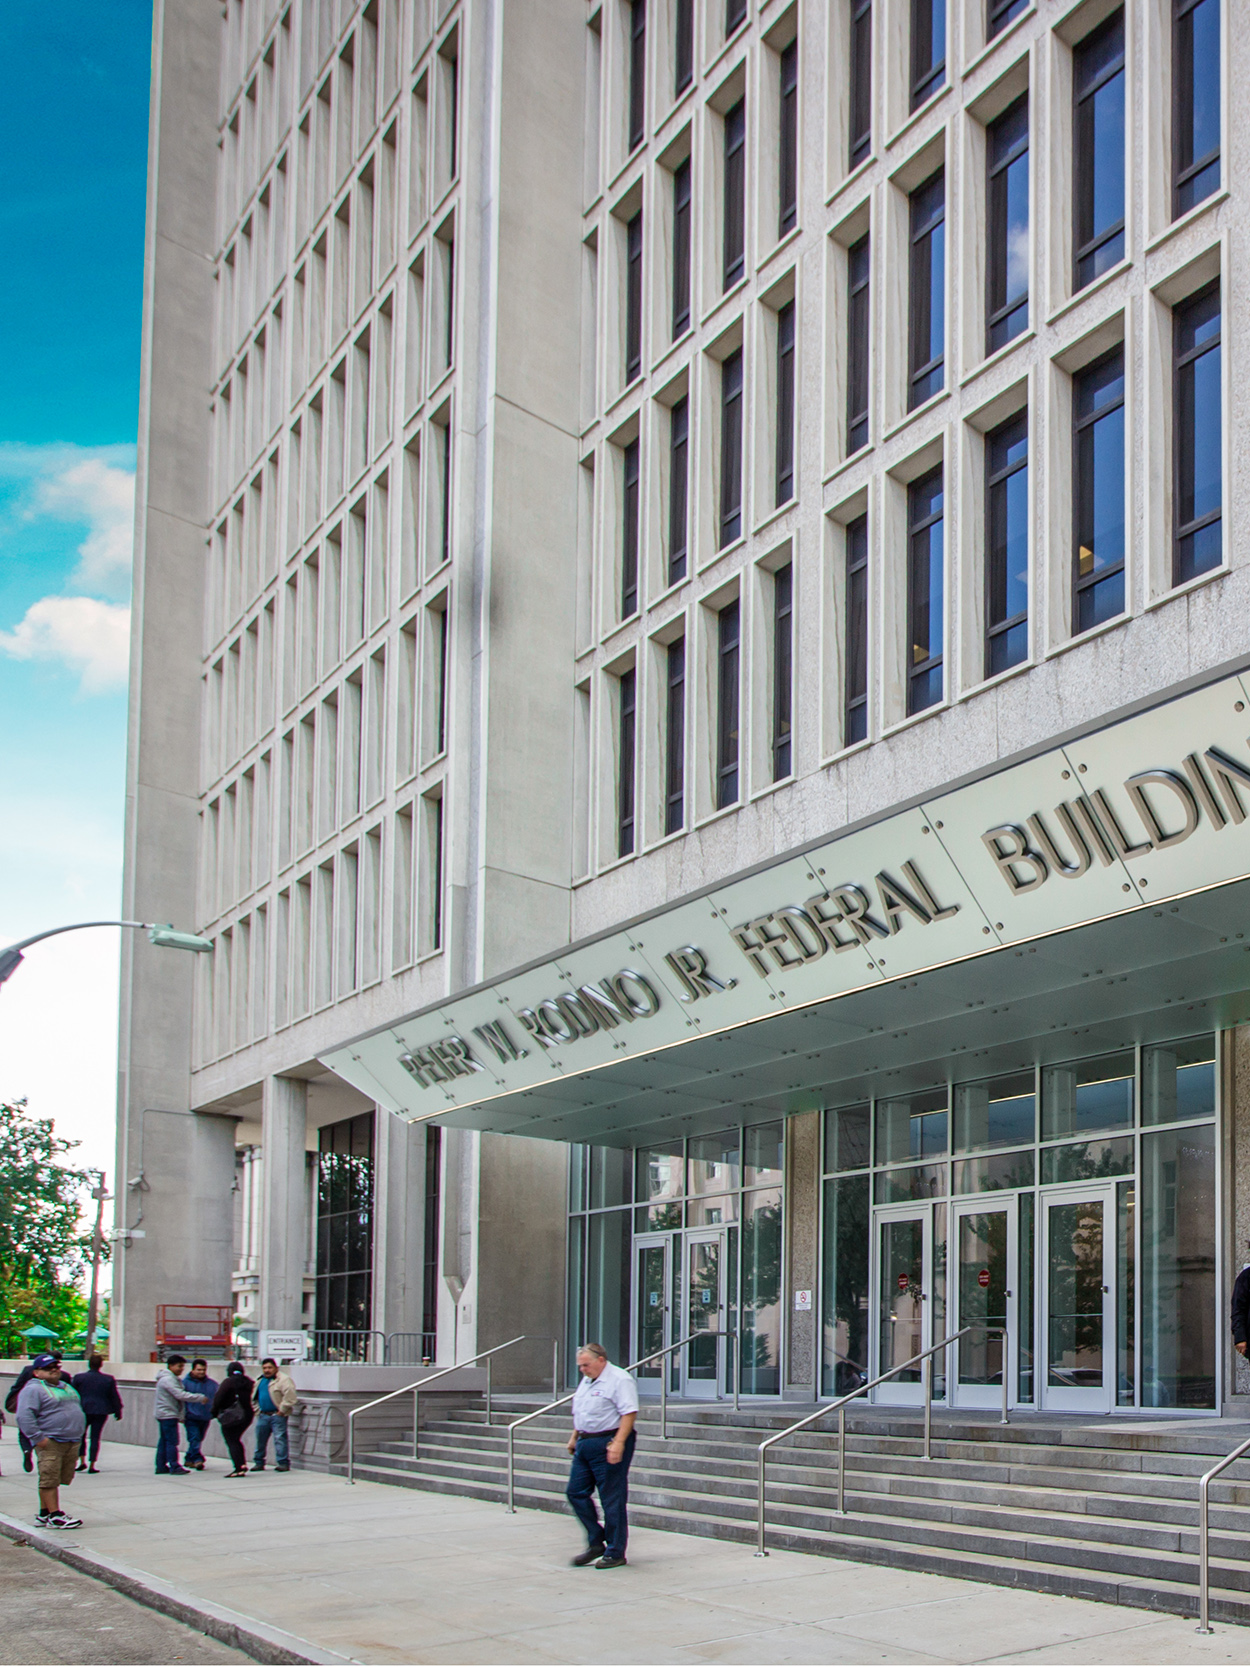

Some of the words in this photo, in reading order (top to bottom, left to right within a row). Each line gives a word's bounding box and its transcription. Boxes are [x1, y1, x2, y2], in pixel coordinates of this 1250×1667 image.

[398, 1036, 486, 1090] PETER
[471, 1020, 529, 1065] W.
[517, 968, 661, 1051] RODINO
[664, 945, 739, 1005] JR.
[729, 859, 961, 980] FEDERAL
